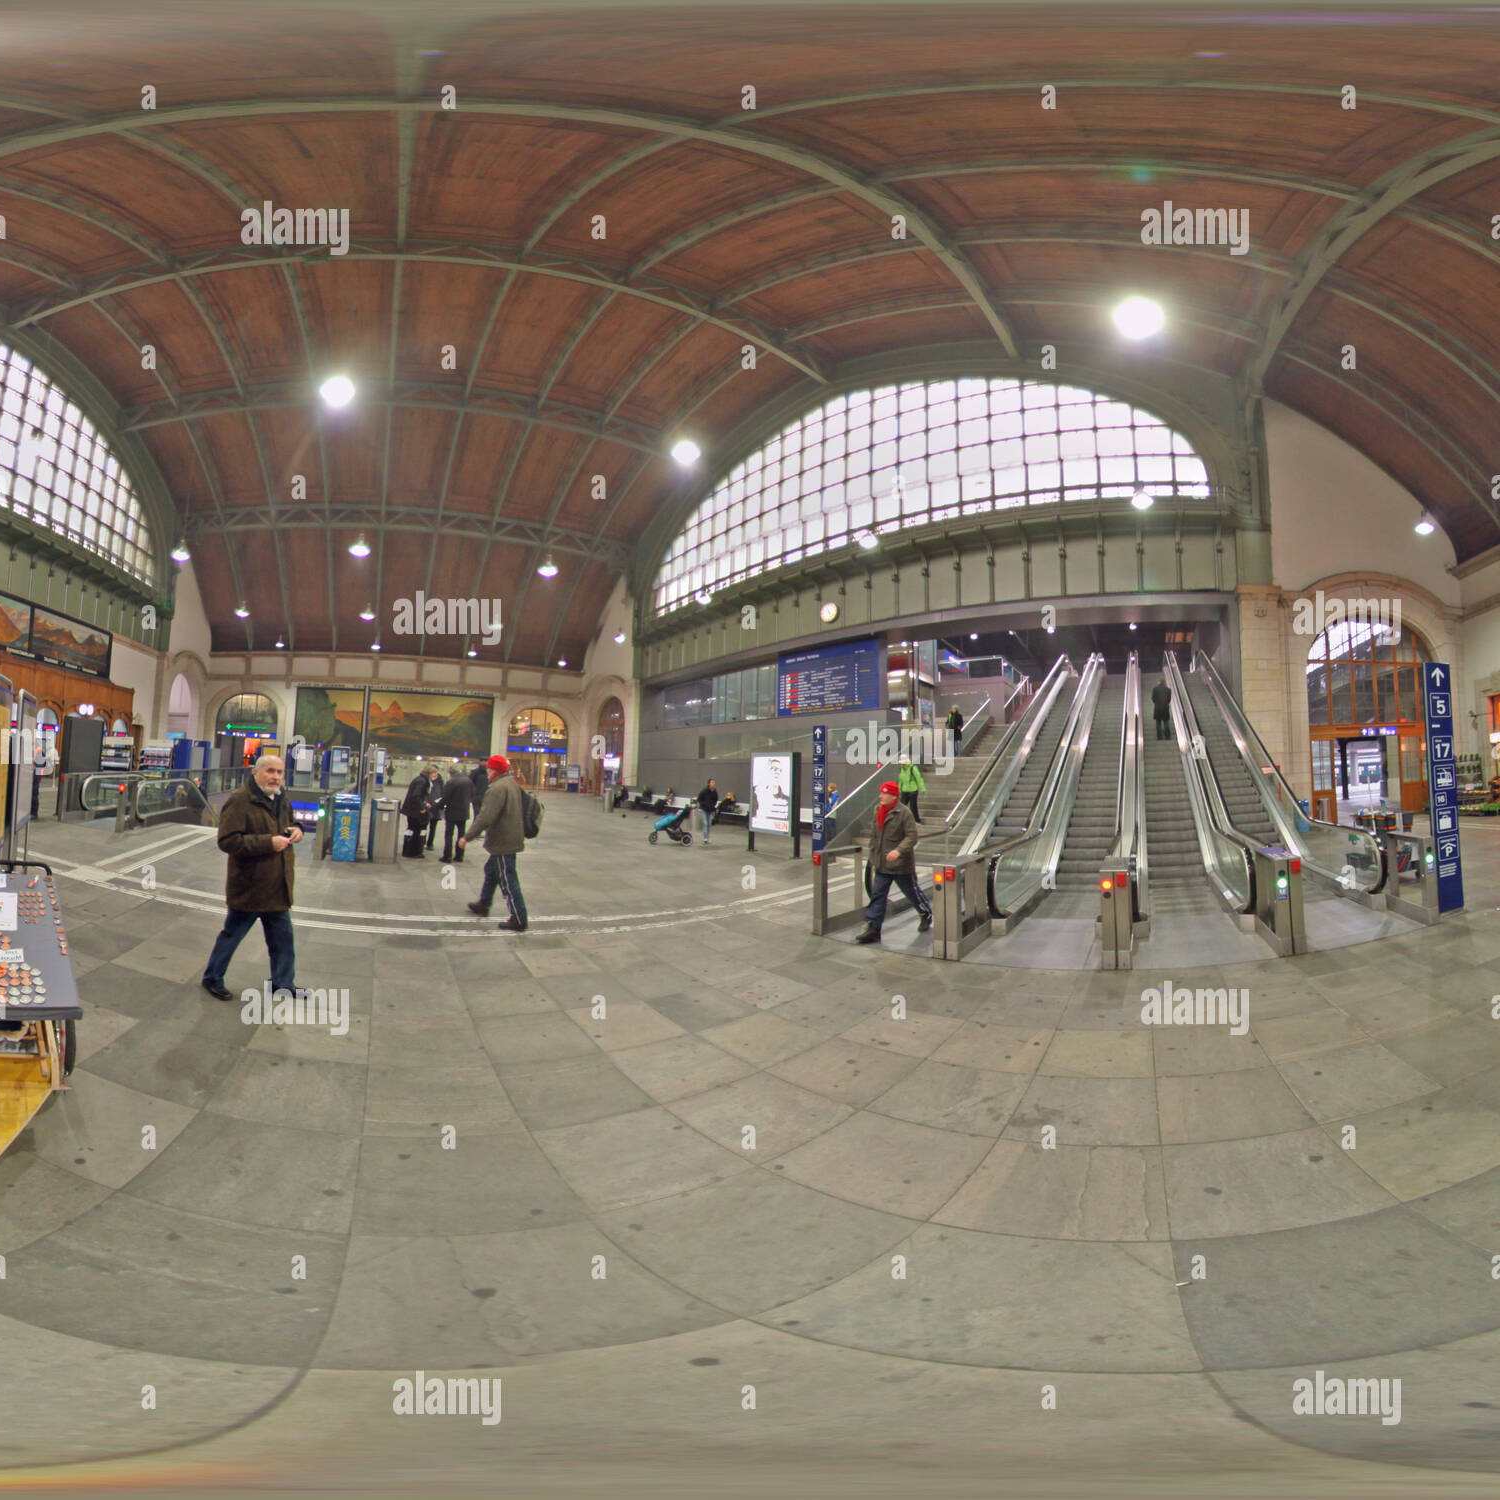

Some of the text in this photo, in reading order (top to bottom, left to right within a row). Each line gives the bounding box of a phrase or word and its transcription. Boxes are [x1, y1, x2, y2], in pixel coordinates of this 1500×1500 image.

[1436, 699, 1446, 714] 5
[1435, 743, 1450, 758] 17
[814, 768, 823, 777] 17
